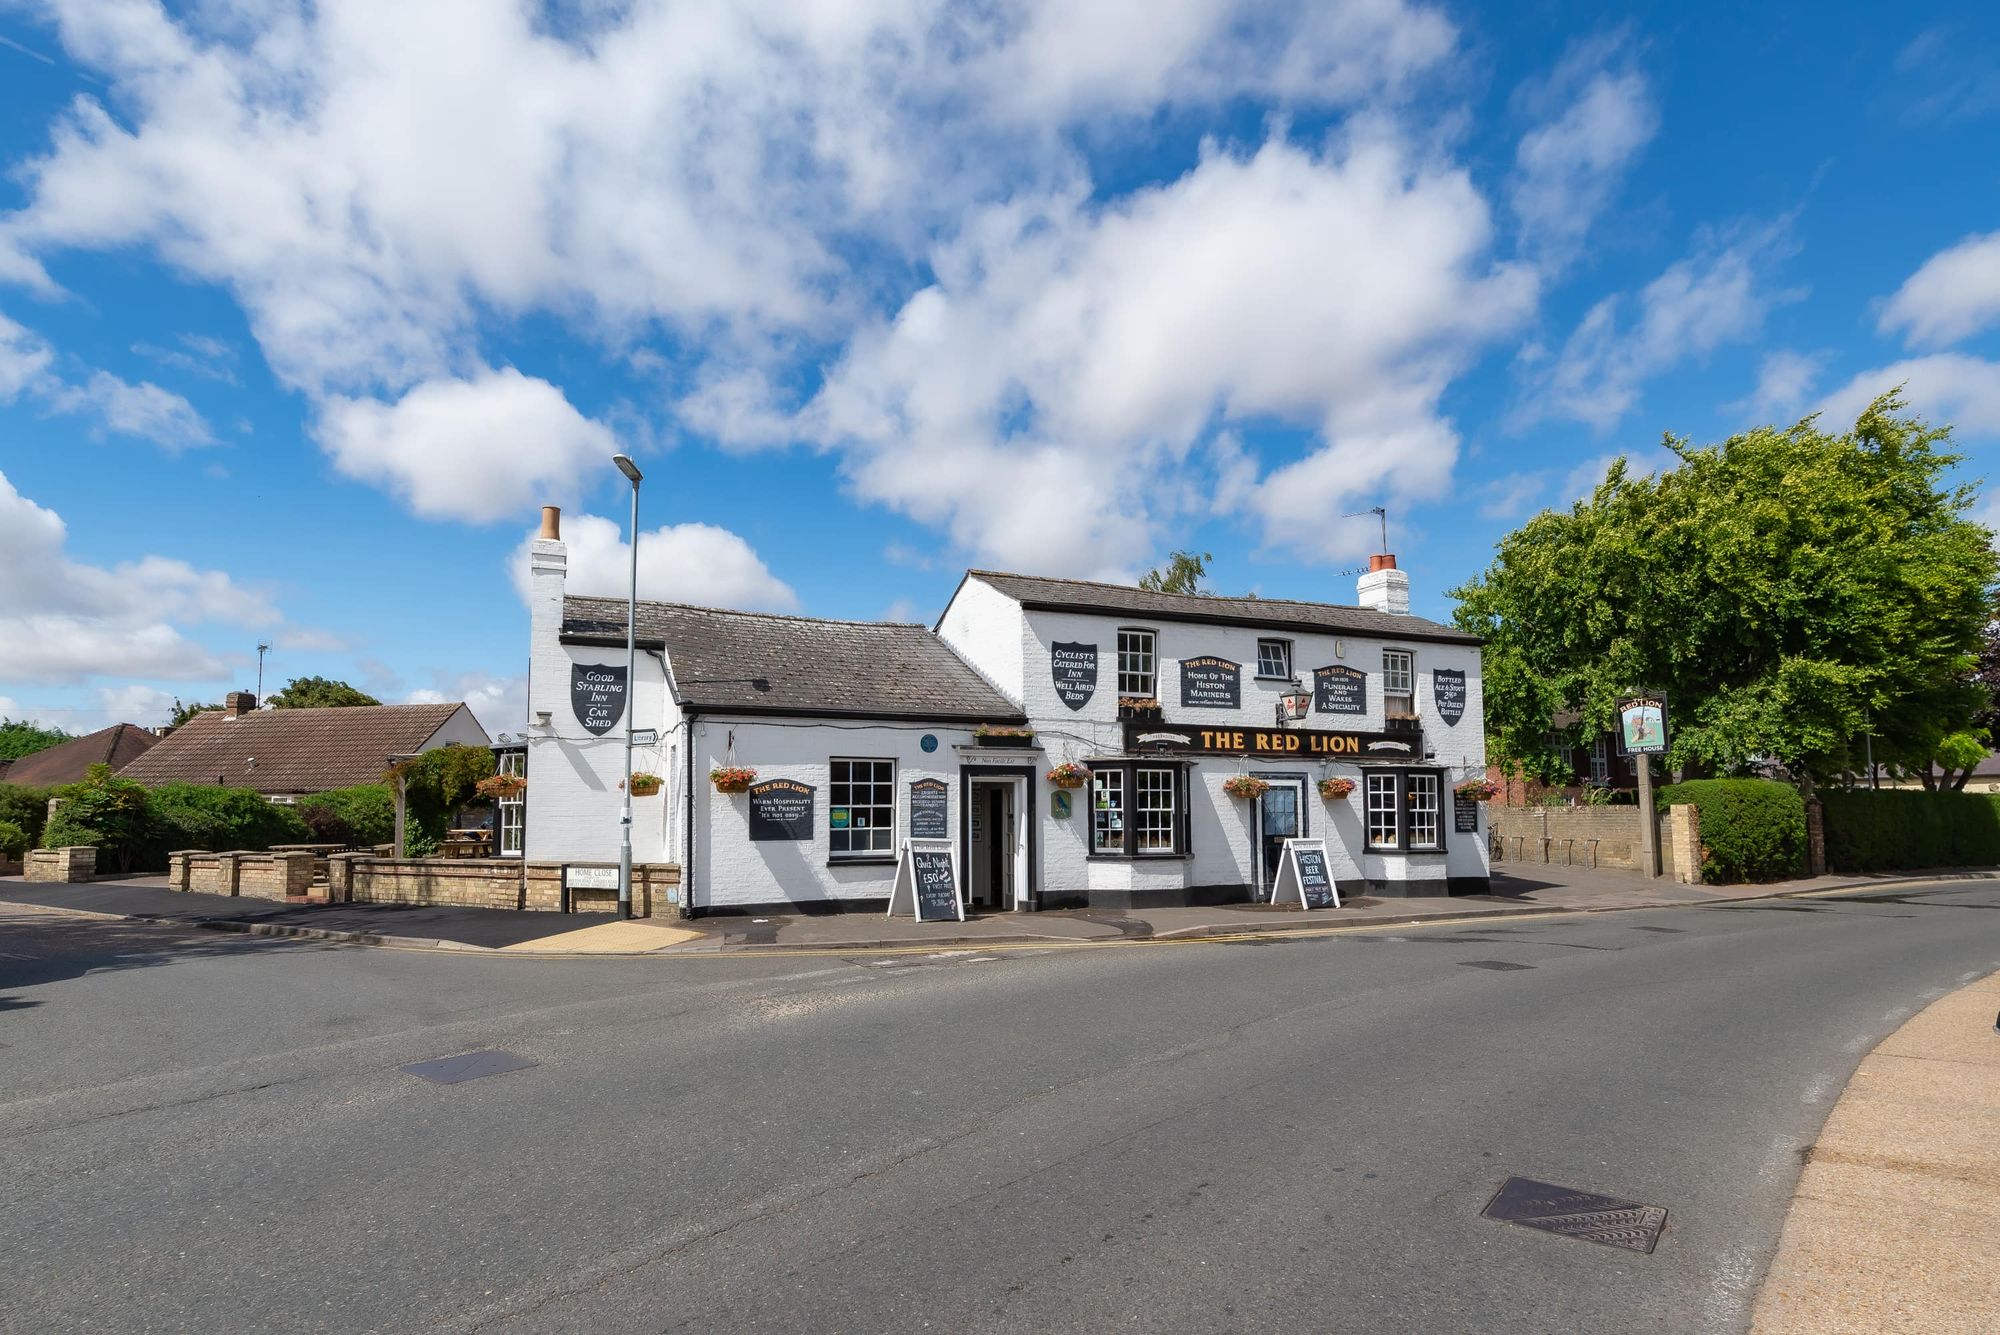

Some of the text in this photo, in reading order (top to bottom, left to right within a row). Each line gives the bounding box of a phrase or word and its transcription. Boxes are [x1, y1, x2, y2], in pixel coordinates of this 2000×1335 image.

[1055, 650, 1094, 659] CYCLISTS
[1053, 659, 1096, 670] CATERED FOR
[1185, 658, 1236, 671] THE RED LION
[586, 672, 614, 681] GOOD
[1067, 669, 1083, 677] INN
[1187, 671, 1234, 681] HOME OF THE
[1346, 670, 1361, 679] LION
[1438, 675, 1461, 683] BOTTLED
[576, 682, 622, 692] STABLING
[1055, 680, 1095, 691] WELL AIRED
[1196, 680, 1226, 690] HISTON
[1323, 682, 1357, 690] FUNERALS
[591, 692, 607, 701] INN
[1065, 691, 1084, 700] BEDS
[1190, 689, 1231, 699] MARINERS
[1619, 700, 1663, 712] RED LION
[589, 708, 607, 716] CAR
[585, 718, 611, 727] SHED
[1201, 731, 1359, 752] THE RED LION
[753, 785, 770, 794] THE
[791, 784, 810, 794] LION
[915, 856, 950, 872] Quiz Night
[1300, 855, 1321, 864] HISTON
[1305, 866, 1319, 874] BEER
[923, 873, 939, 884] £50
[1303, 875, 1326, 884] FESTIVAL
